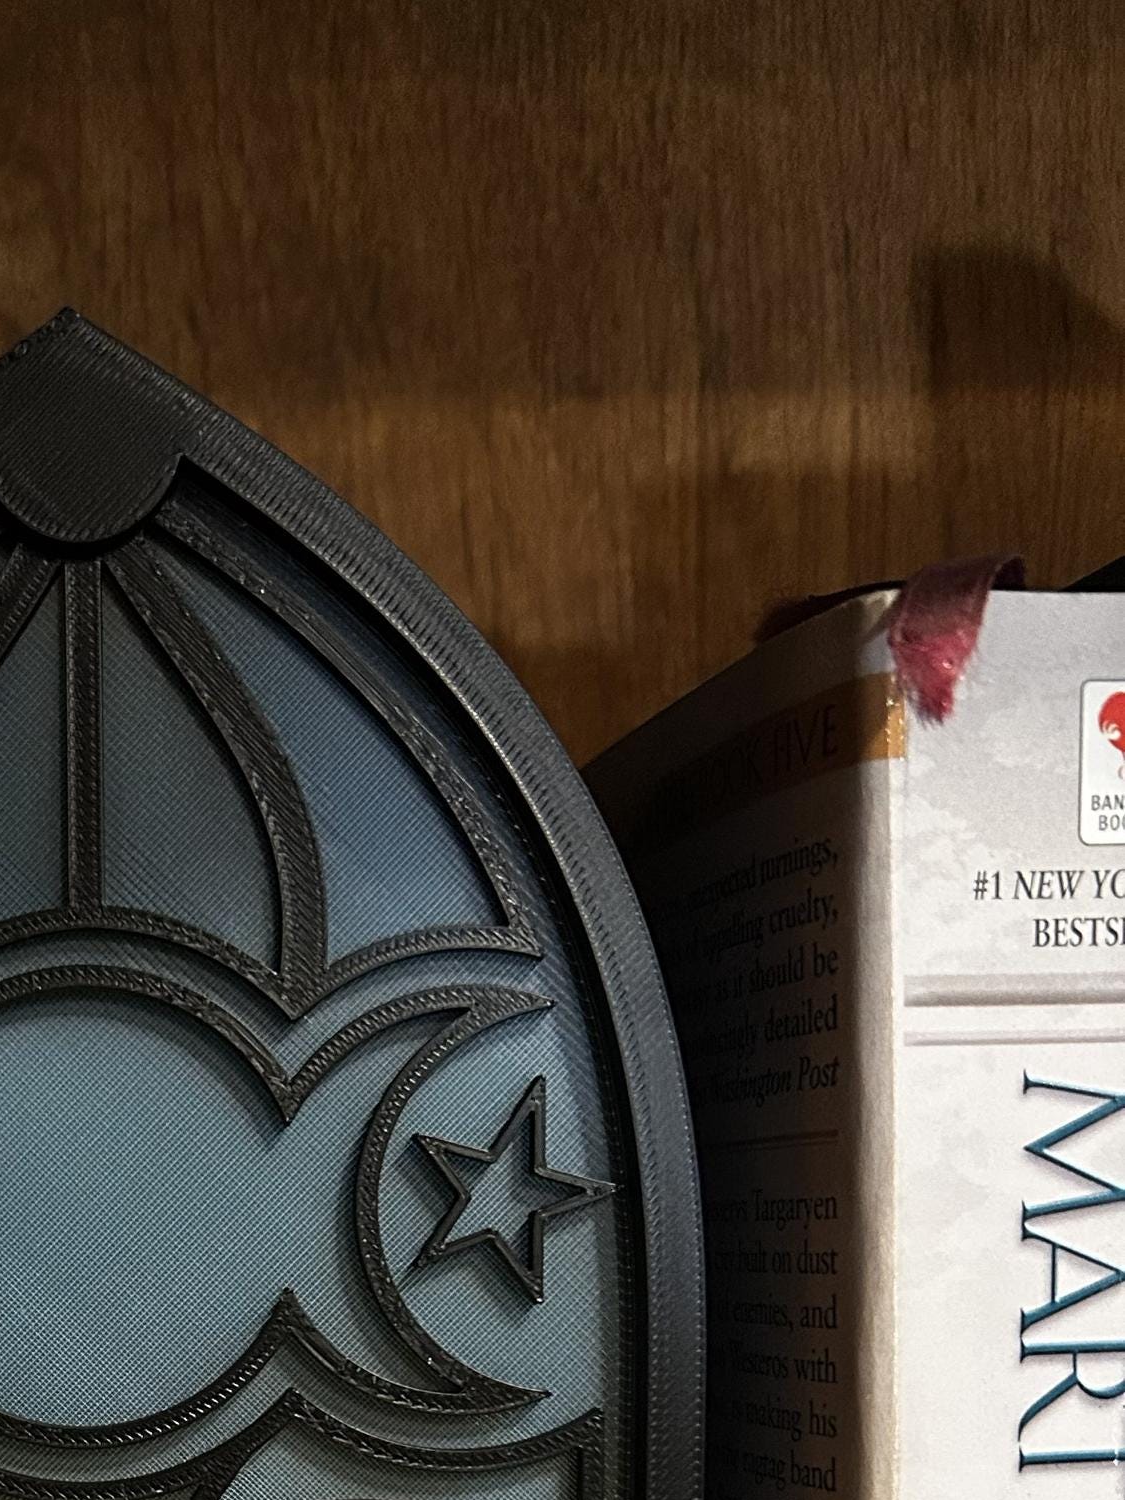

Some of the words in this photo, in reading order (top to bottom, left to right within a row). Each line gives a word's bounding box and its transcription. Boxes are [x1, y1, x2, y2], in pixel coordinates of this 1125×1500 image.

[1091, 794, 1125, 811] BAN
[972, 870, 1003, 901] #1
[1013, 869, 1085, 901] NEW
[1093, 869, 1125, 901] YO
[769, 887, 839, 931] cruelty,
[748, 943, 805, 994] should
[813, 941, 839, 978] be
[764, 993, 838, 1044] detailed
[796, 1055, 840, 1092] Post
[751, 1188, 838, 1231] Targaryen
[771, 1250, 792, 1275] on
[796, 1238, 838, 1276] dust
[799, 1293, 838, 1330] and
[793, 1347, 838, 1384] with
[807, 1399, 838, 1439] his
[790, 1448, 838, 1493] band
